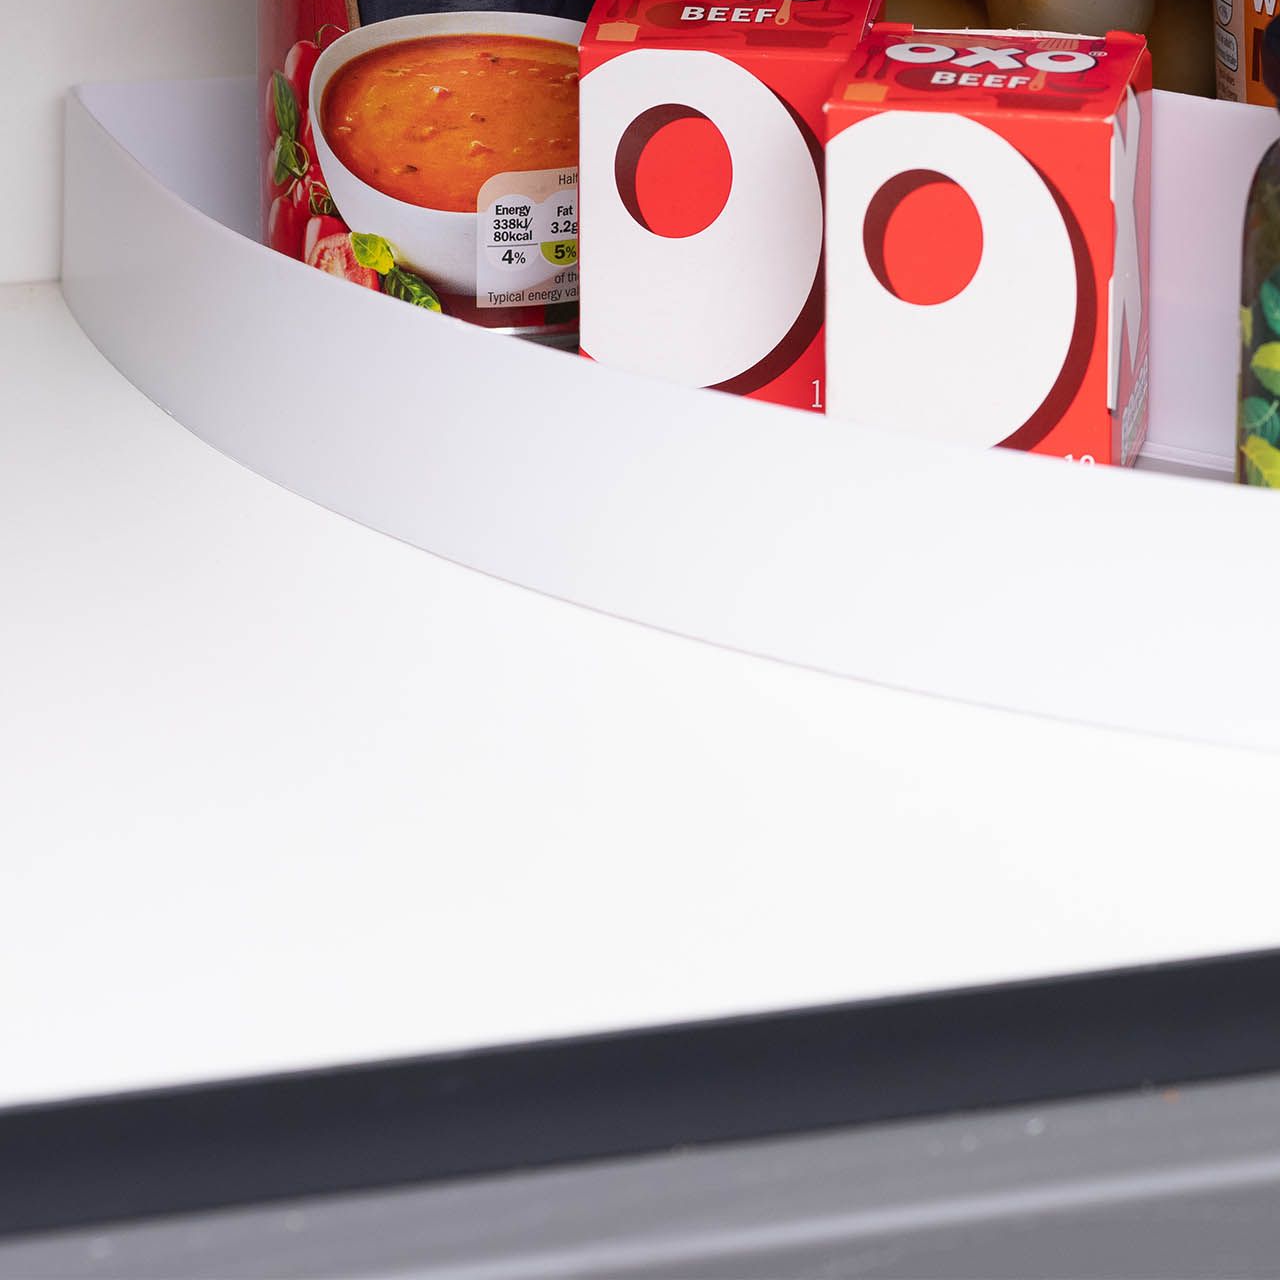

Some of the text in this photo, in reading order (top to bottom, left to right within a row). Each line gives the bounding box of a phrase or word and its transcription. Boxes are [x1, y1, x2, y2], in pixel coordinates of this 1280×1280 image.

[680, 6, 777, 24] BEEF
[885, 42, 1097, 73] OXO
[930, 70, 1031, 90] BEEF
[495, 205, 573, 217] Energy Fat
[493, 230, 532, 242] 80kcal
[501, 244, 577, 264] 4% 5%
[554, 273, 565, 283] of
[488, 291, 525, 305] Typical
[528, 289, 562, 301] energy
